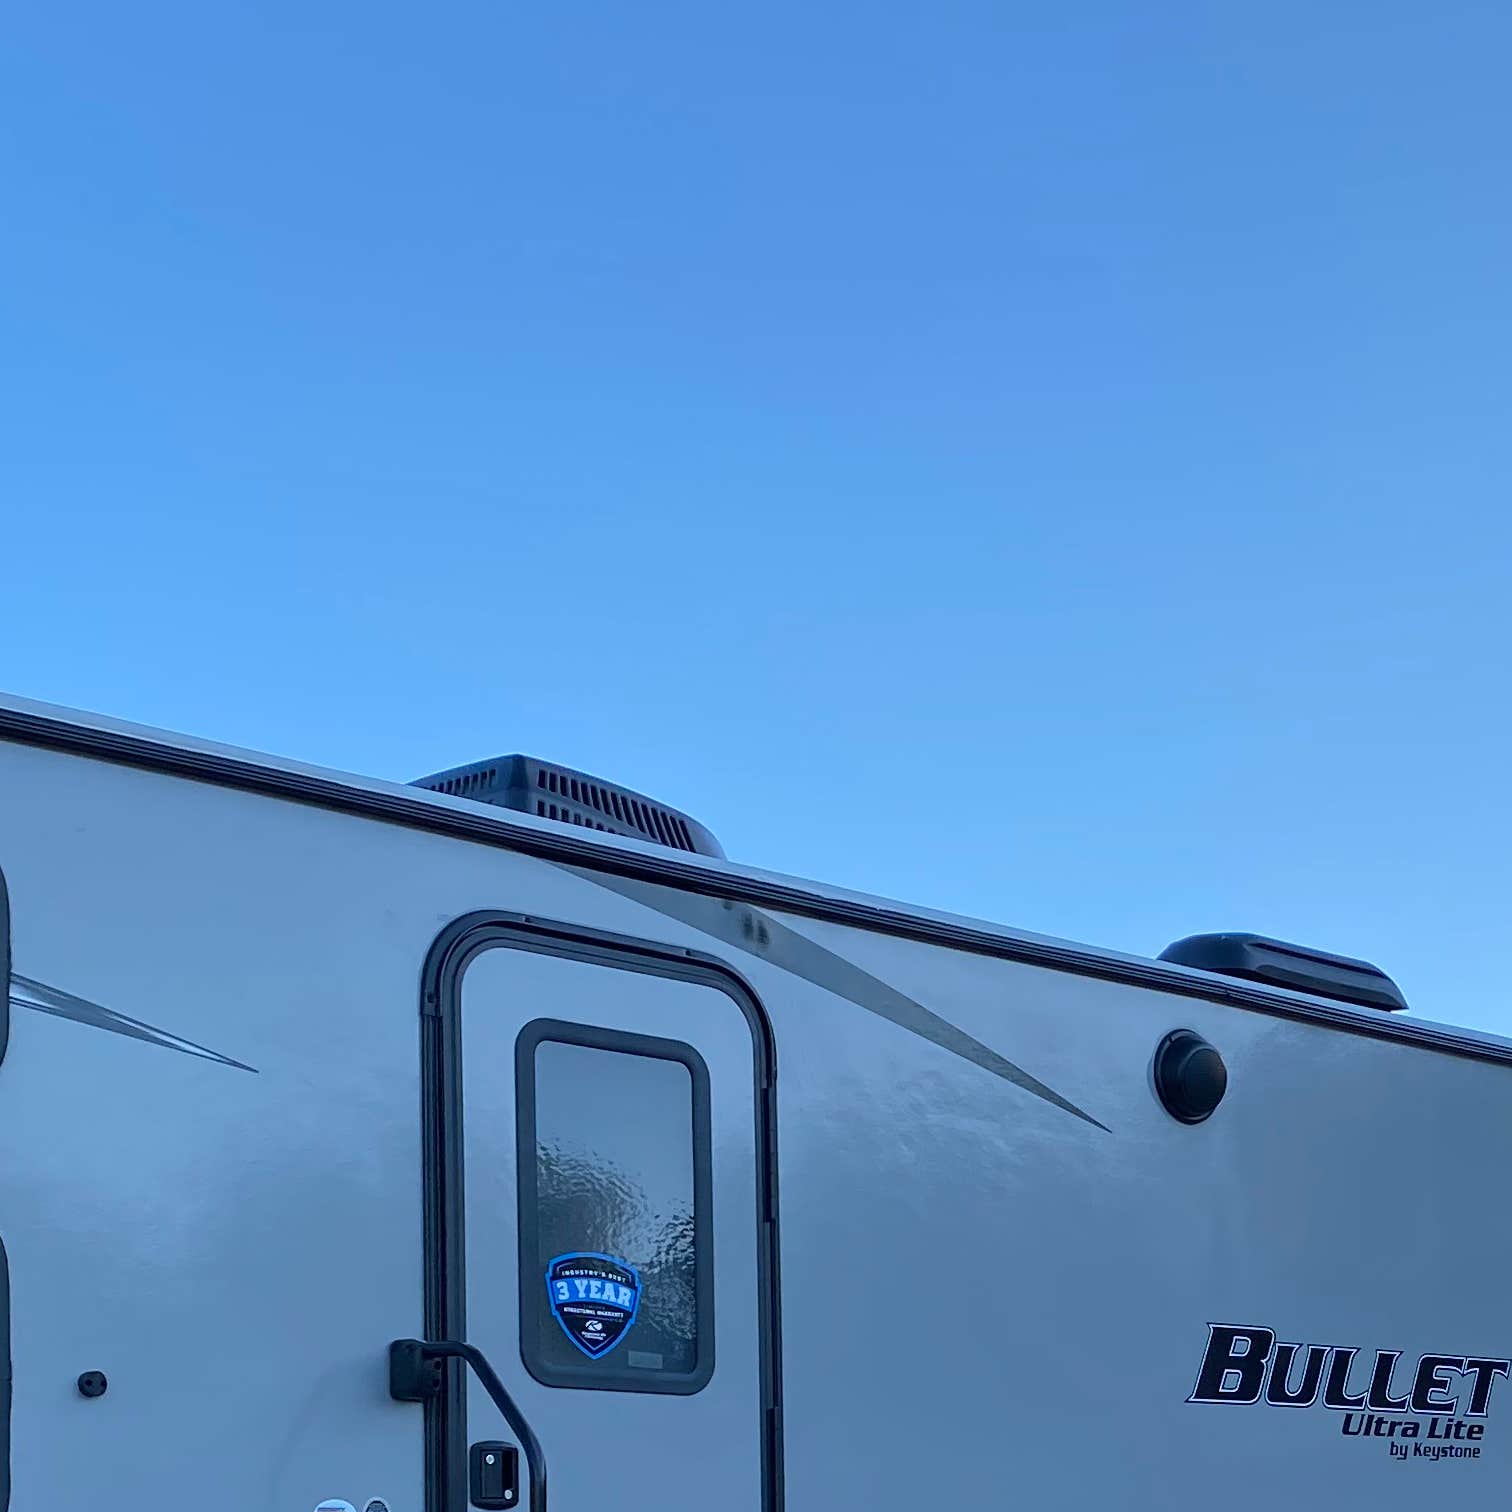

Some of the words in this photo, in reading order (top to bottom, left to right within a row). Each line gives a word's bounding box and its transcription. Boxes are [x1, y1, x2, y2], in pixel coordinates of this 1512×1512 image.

[556, 1281, 570, 1301] 3
[574, 1279, 632, 1307] YEAR
[1184, 1322, 1512, 1418] BULLET
[1341, 1412, 1421, 1438] Ultra
[1426, 1417, 1485, 1441] Lite
[1389, 1441, 1409, 1461] by
[1412, 1441, 1482, 1462] Keystone
